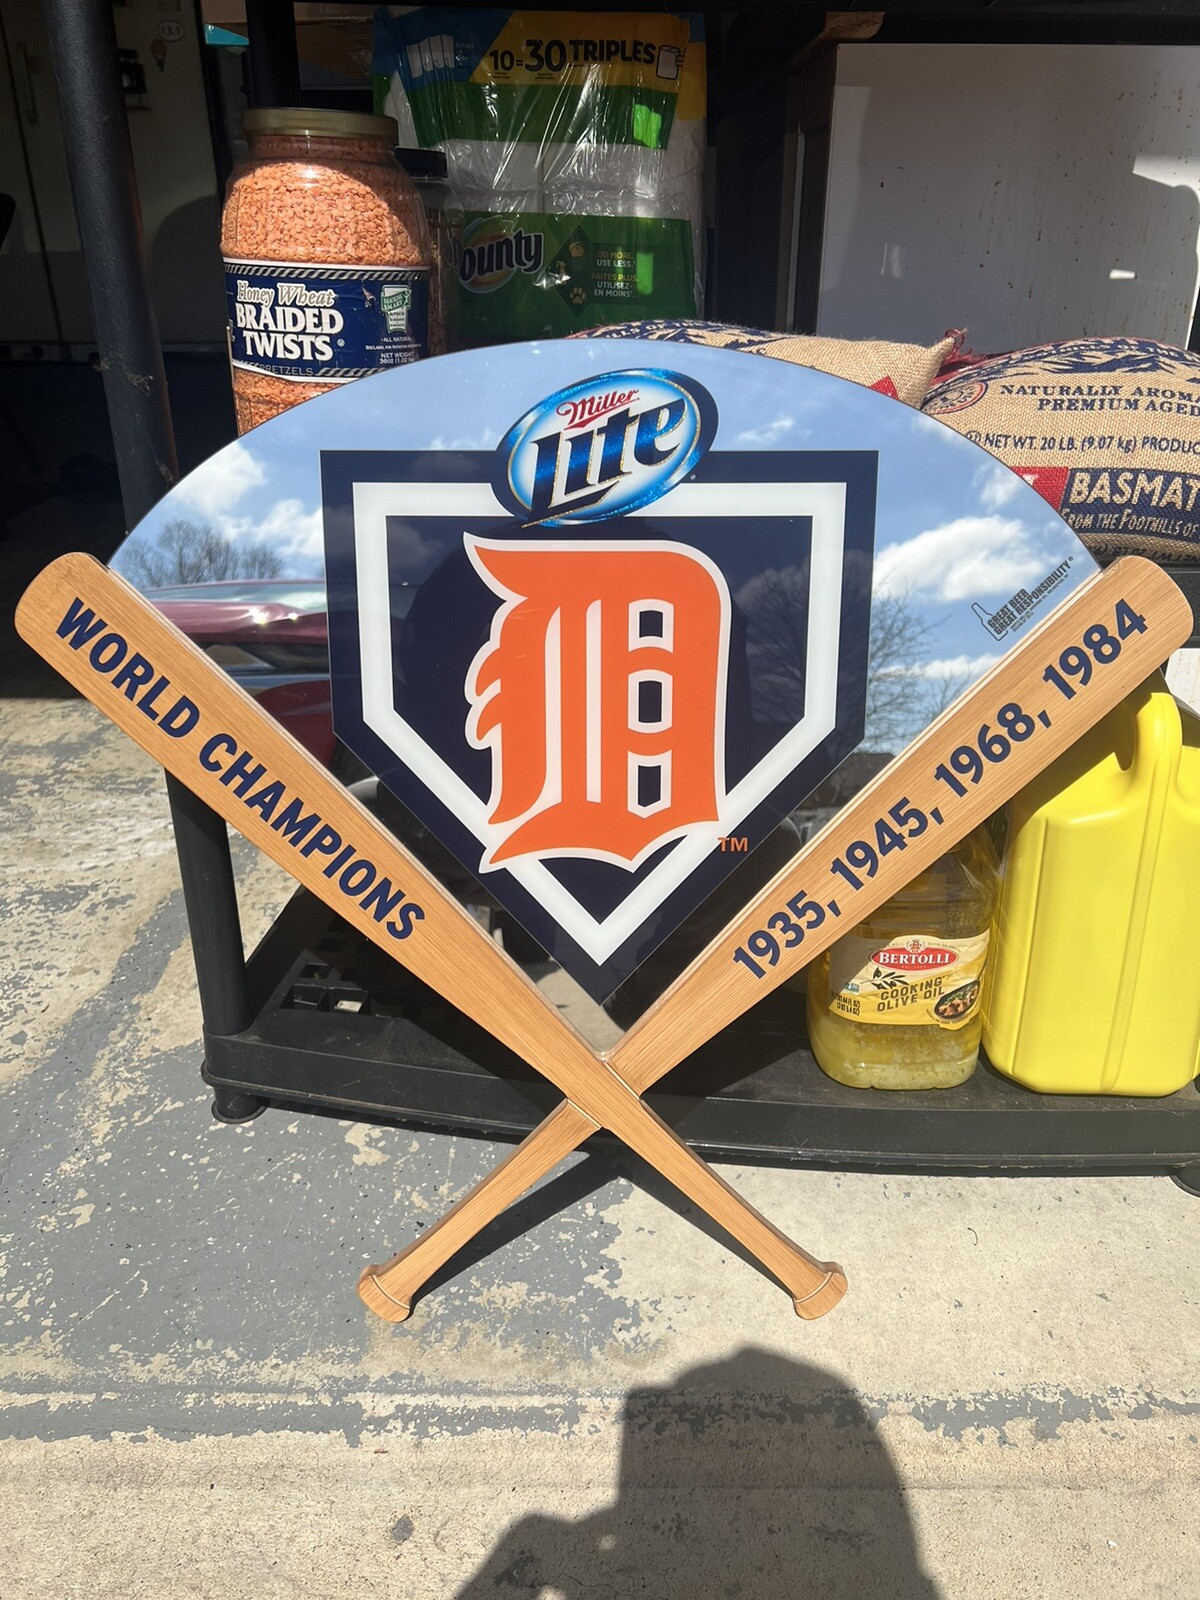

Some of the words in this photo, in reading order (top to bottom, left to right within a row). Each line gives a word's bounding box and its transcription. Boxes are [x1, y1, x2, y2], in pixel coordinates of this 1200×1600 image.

[569, 39, 656, 64] TRIPLES
[596, 259, 612, 267] USE
[597, 250, 609, 259] DO
[591, 272, 617, 281] FAITES
[237, 280, 275, 308] Honey
[276, 283, 339, 307] Wheat
[594, 289, 604, 297] EN
[235, 303, 344, 334] BRAIDED
[243, 330, 334, 361] TWISTS
[1000, 384, 1123, 396] NATURALLY
[556, 389, 640, 430] Miller
[1037, 398, 1142, 411] PREMIUM
[1144, 400, 1200, 416] AGED
[984, 433, 1012, 449] NET
[1039, 436, 1055, 450] 20
[1058, 436, 1078, 450] LB.
[1116, 434, 1137, 454] kg)
[1141, 436, 1200, 455] PRODUC
[522, 398, 688, 528] Lite
[1069, 472, 1200, 512] BASMAT
[987, 604, 1012, 629] GREAT
[1008, 588, 1030, 609] BEER
[993, 610, 1018, 635] GREAT
[464, 532, 732, 873] D
[55, 597, 200, 739] WORLD
[199, 732, 426, 940] CHAMPIONS
[732, 889, 843, 979] 1935,
[830, 796, 945, 891] 1945,
[933, 702, 1053, 798] 1968,
[1042, 598, 1148, 700] 1984
[879, 951, 950, 965] BERTOLLI
[876, 995, 918, 1012] OLIVE
[923, 987, 945, 1000] OIL
[880, 976, 943, 1001] COOKING
